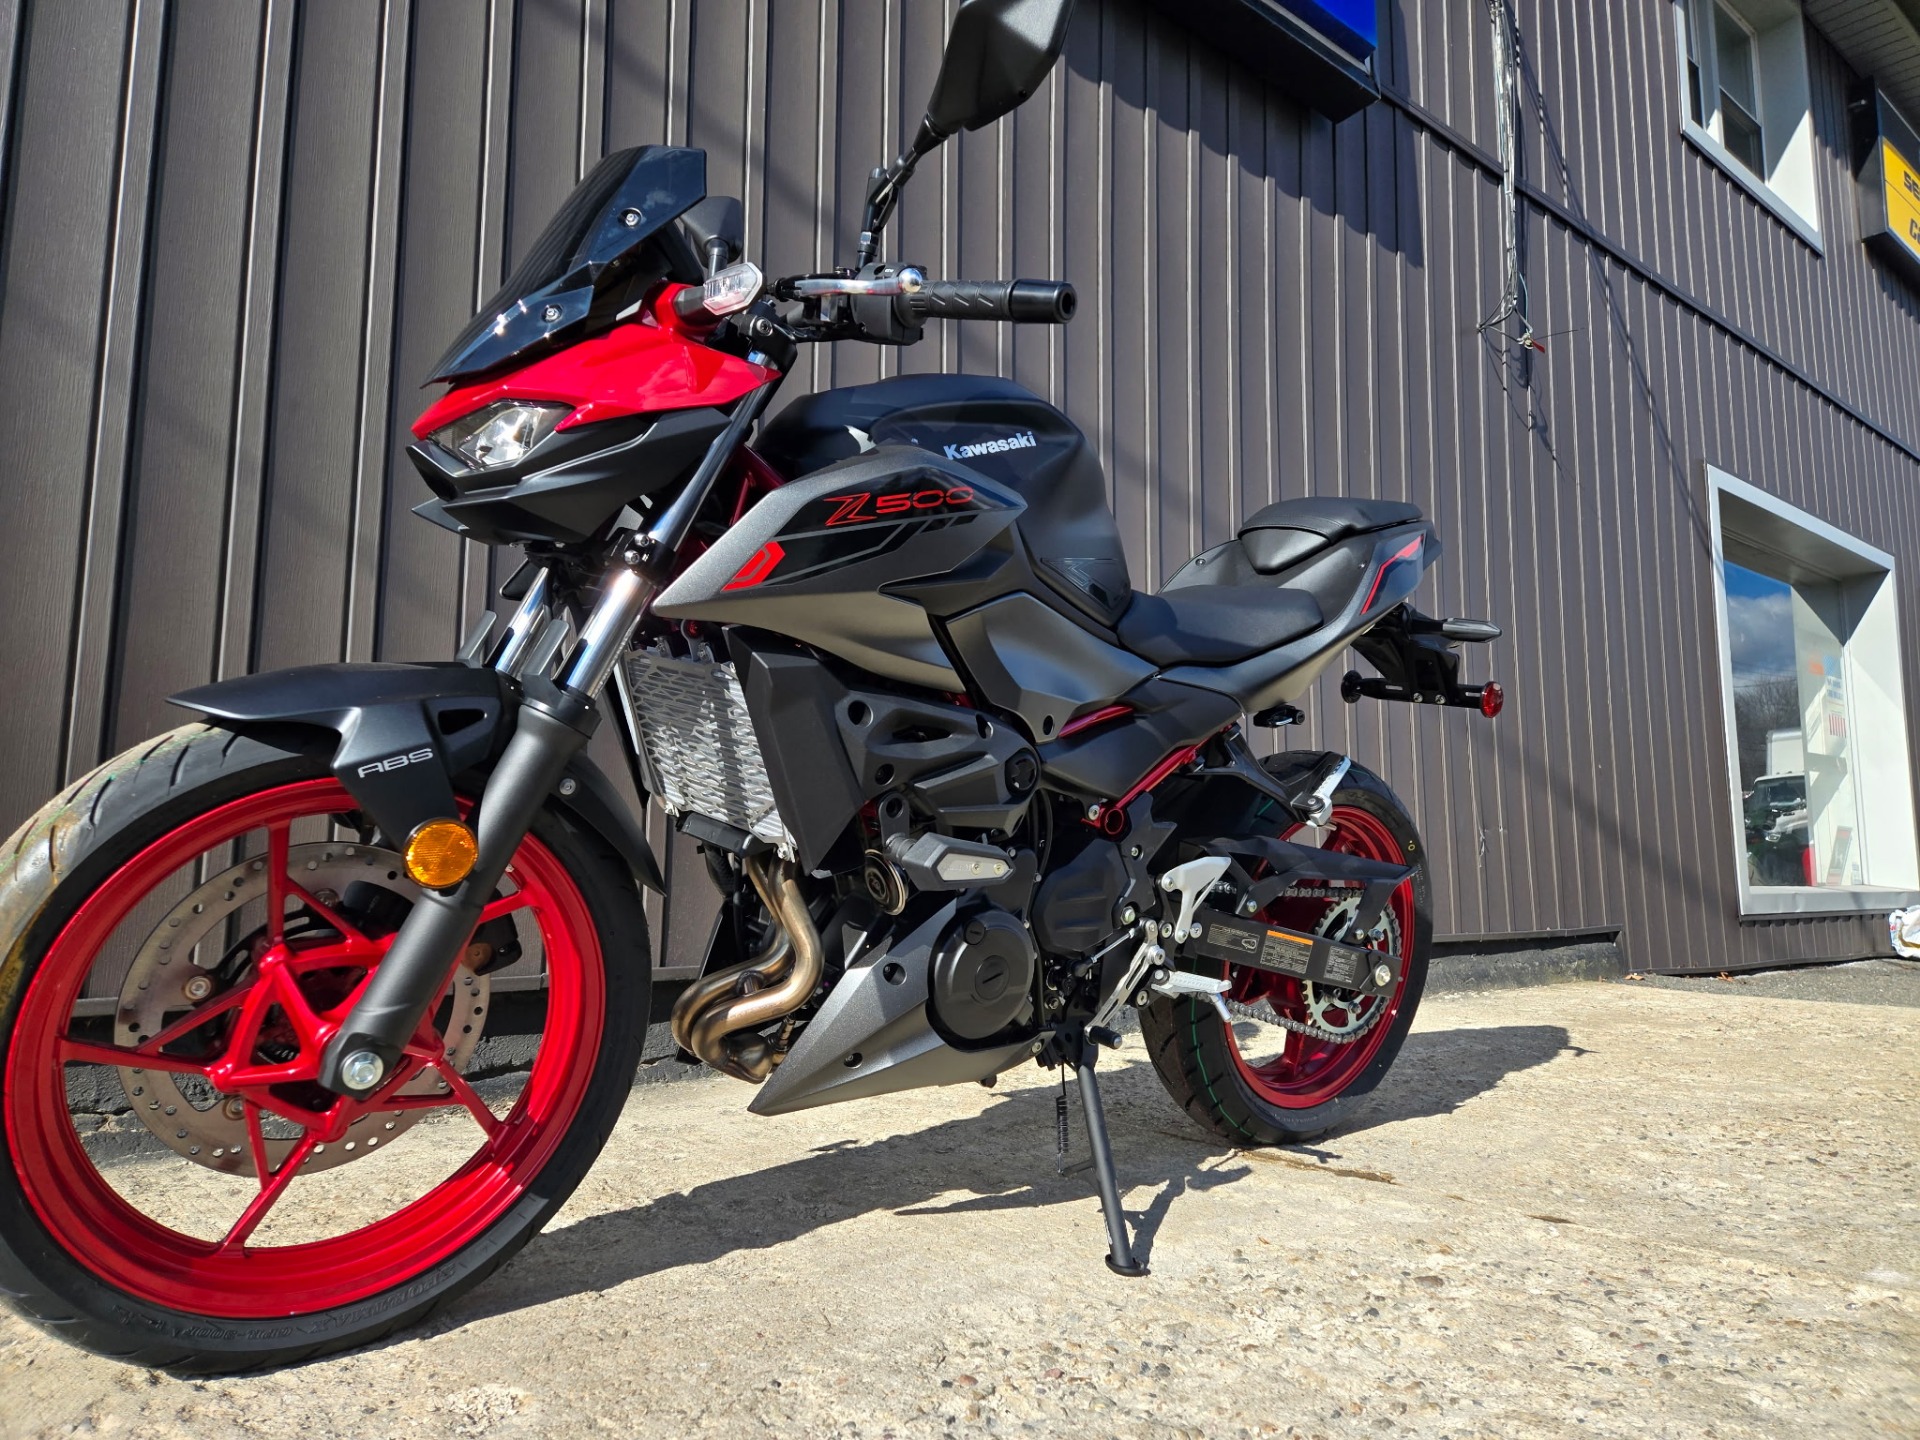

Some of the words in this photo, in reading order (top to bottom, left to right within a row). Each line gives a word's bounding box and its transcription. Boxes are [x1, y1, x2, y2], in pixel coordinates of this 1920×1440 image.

[943, 430, 1036, 460] Kawasaki
[823, 486, 975, 527] Z500
[357, 748, 433, 778] ABS
